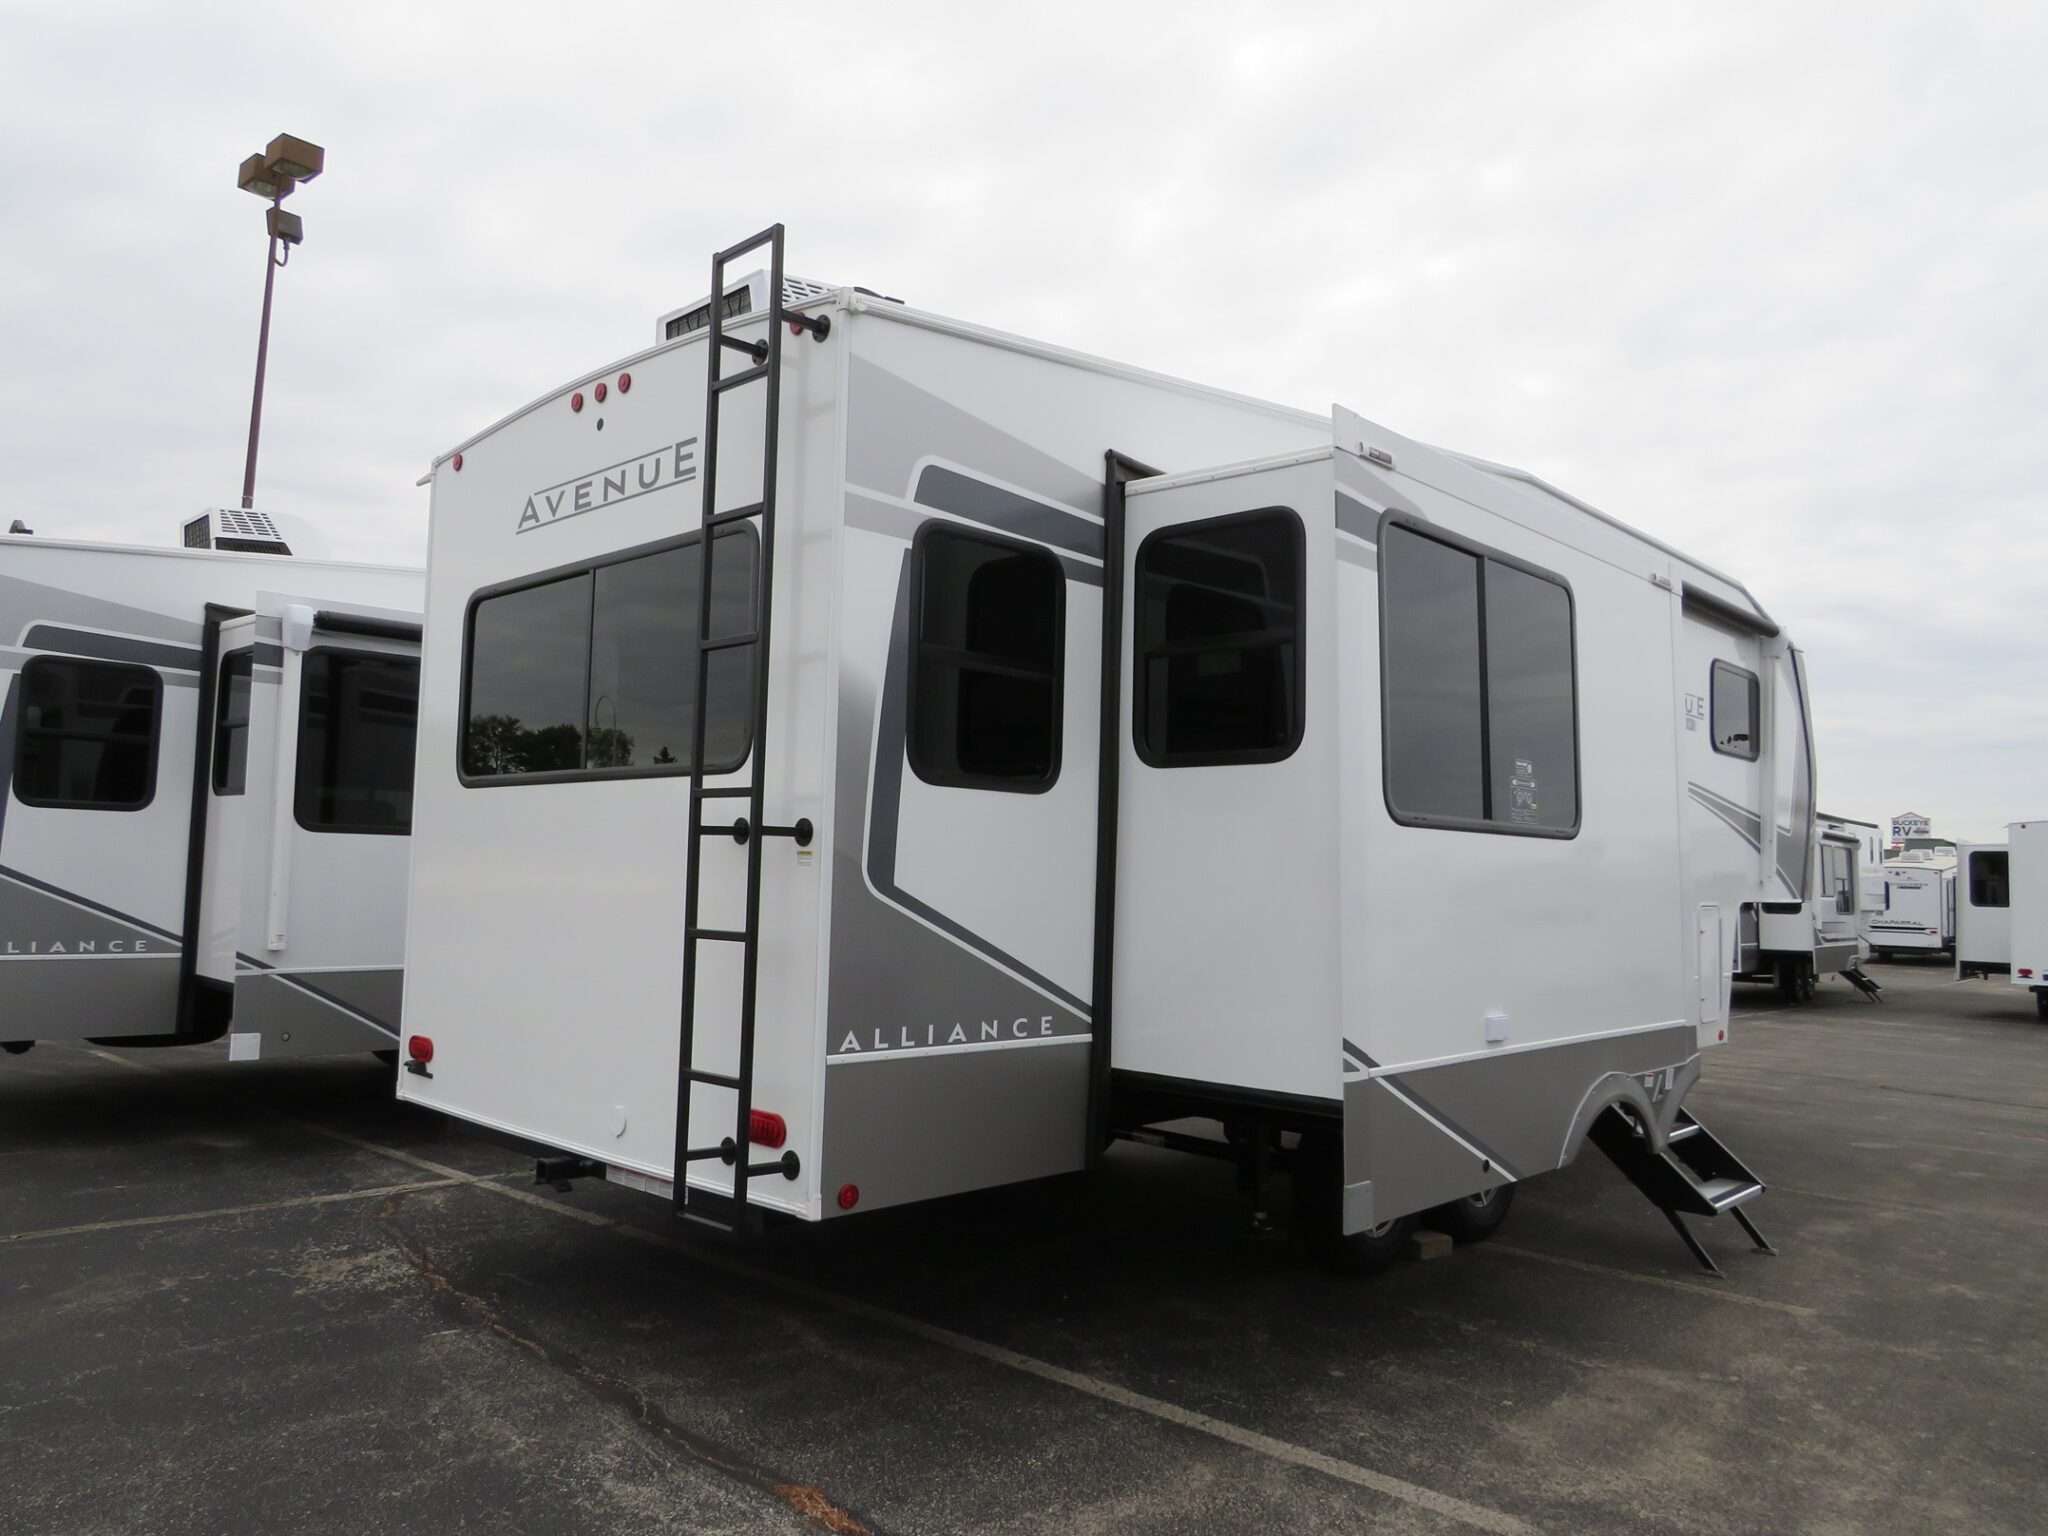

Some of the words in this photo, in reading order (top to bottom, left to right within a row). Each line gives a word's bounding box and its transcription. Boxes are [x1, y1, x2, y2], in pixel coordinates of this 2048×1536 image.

[517, 436, 698, 529] AVENUE
[1892, 826, 1912, 837] RV
[839, 1016, 1054, 1052] ALLIANCE
